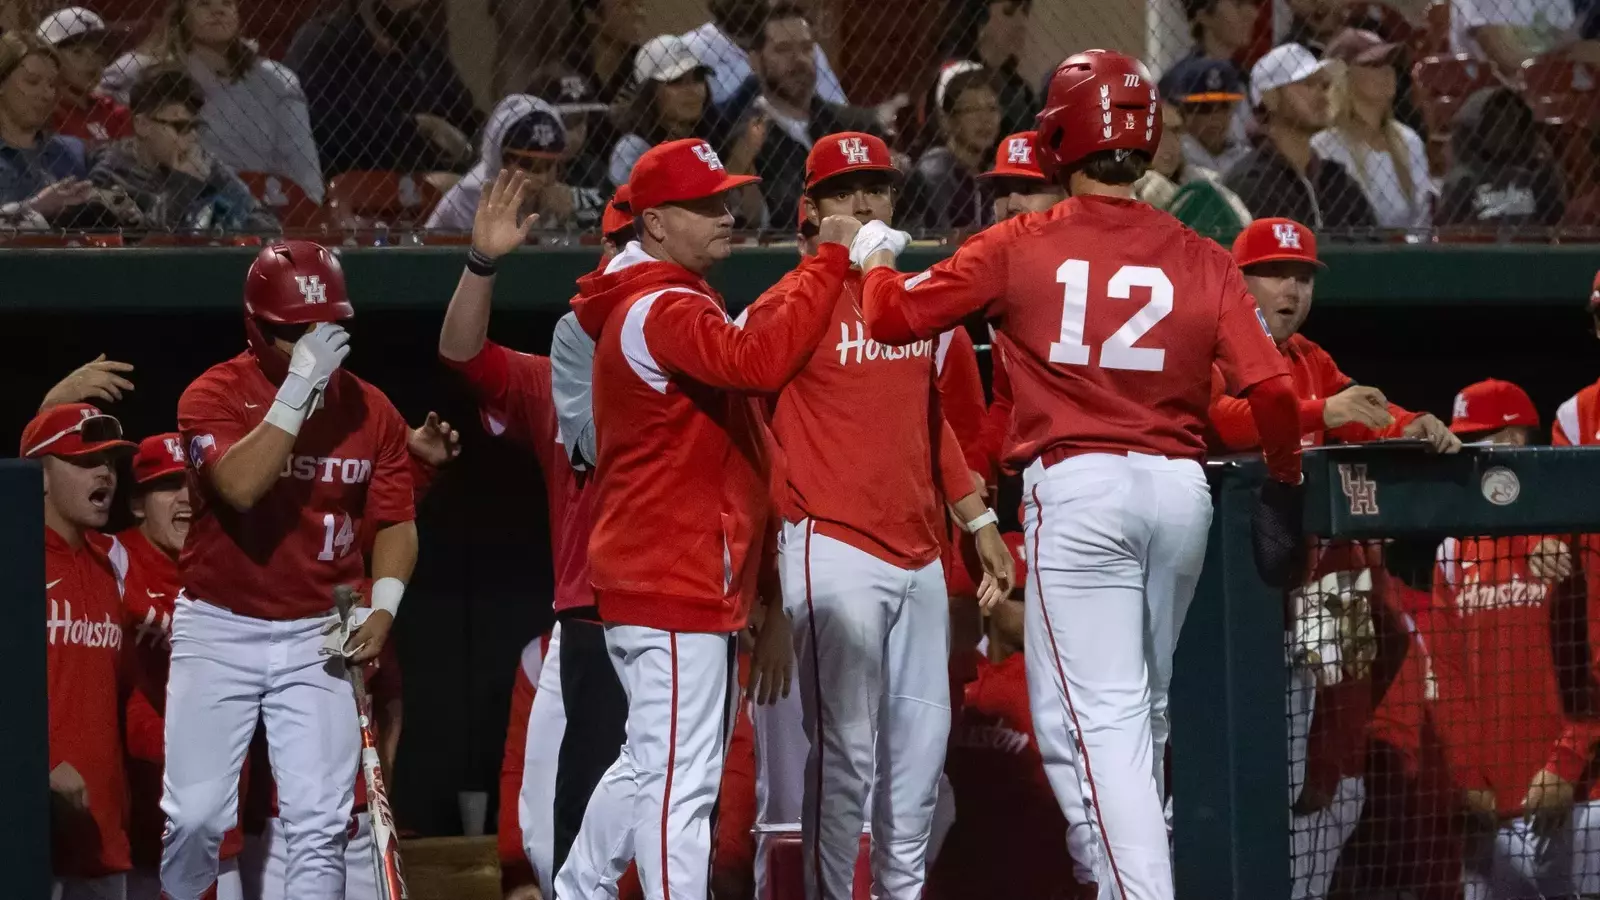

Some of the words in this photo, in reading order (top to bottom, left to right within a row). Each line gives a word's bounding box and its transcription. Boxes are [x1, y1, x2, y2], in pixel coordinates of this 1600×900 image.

[1125, 122, 1135, 130] 12
[691, 143, 723, 171] UH
[838, 137, 871, 164] UH
[1008, 138, 1032, 164] UH
[1271, 223, 1303, 250] UH
[295, 275, 327, 304] UH
[1049, 258, 1174, 372] 12
[280, 453, 372, 484] USTON
[1338, 464, 1379, 515] UH
[317, 511, 354, 561] 14
